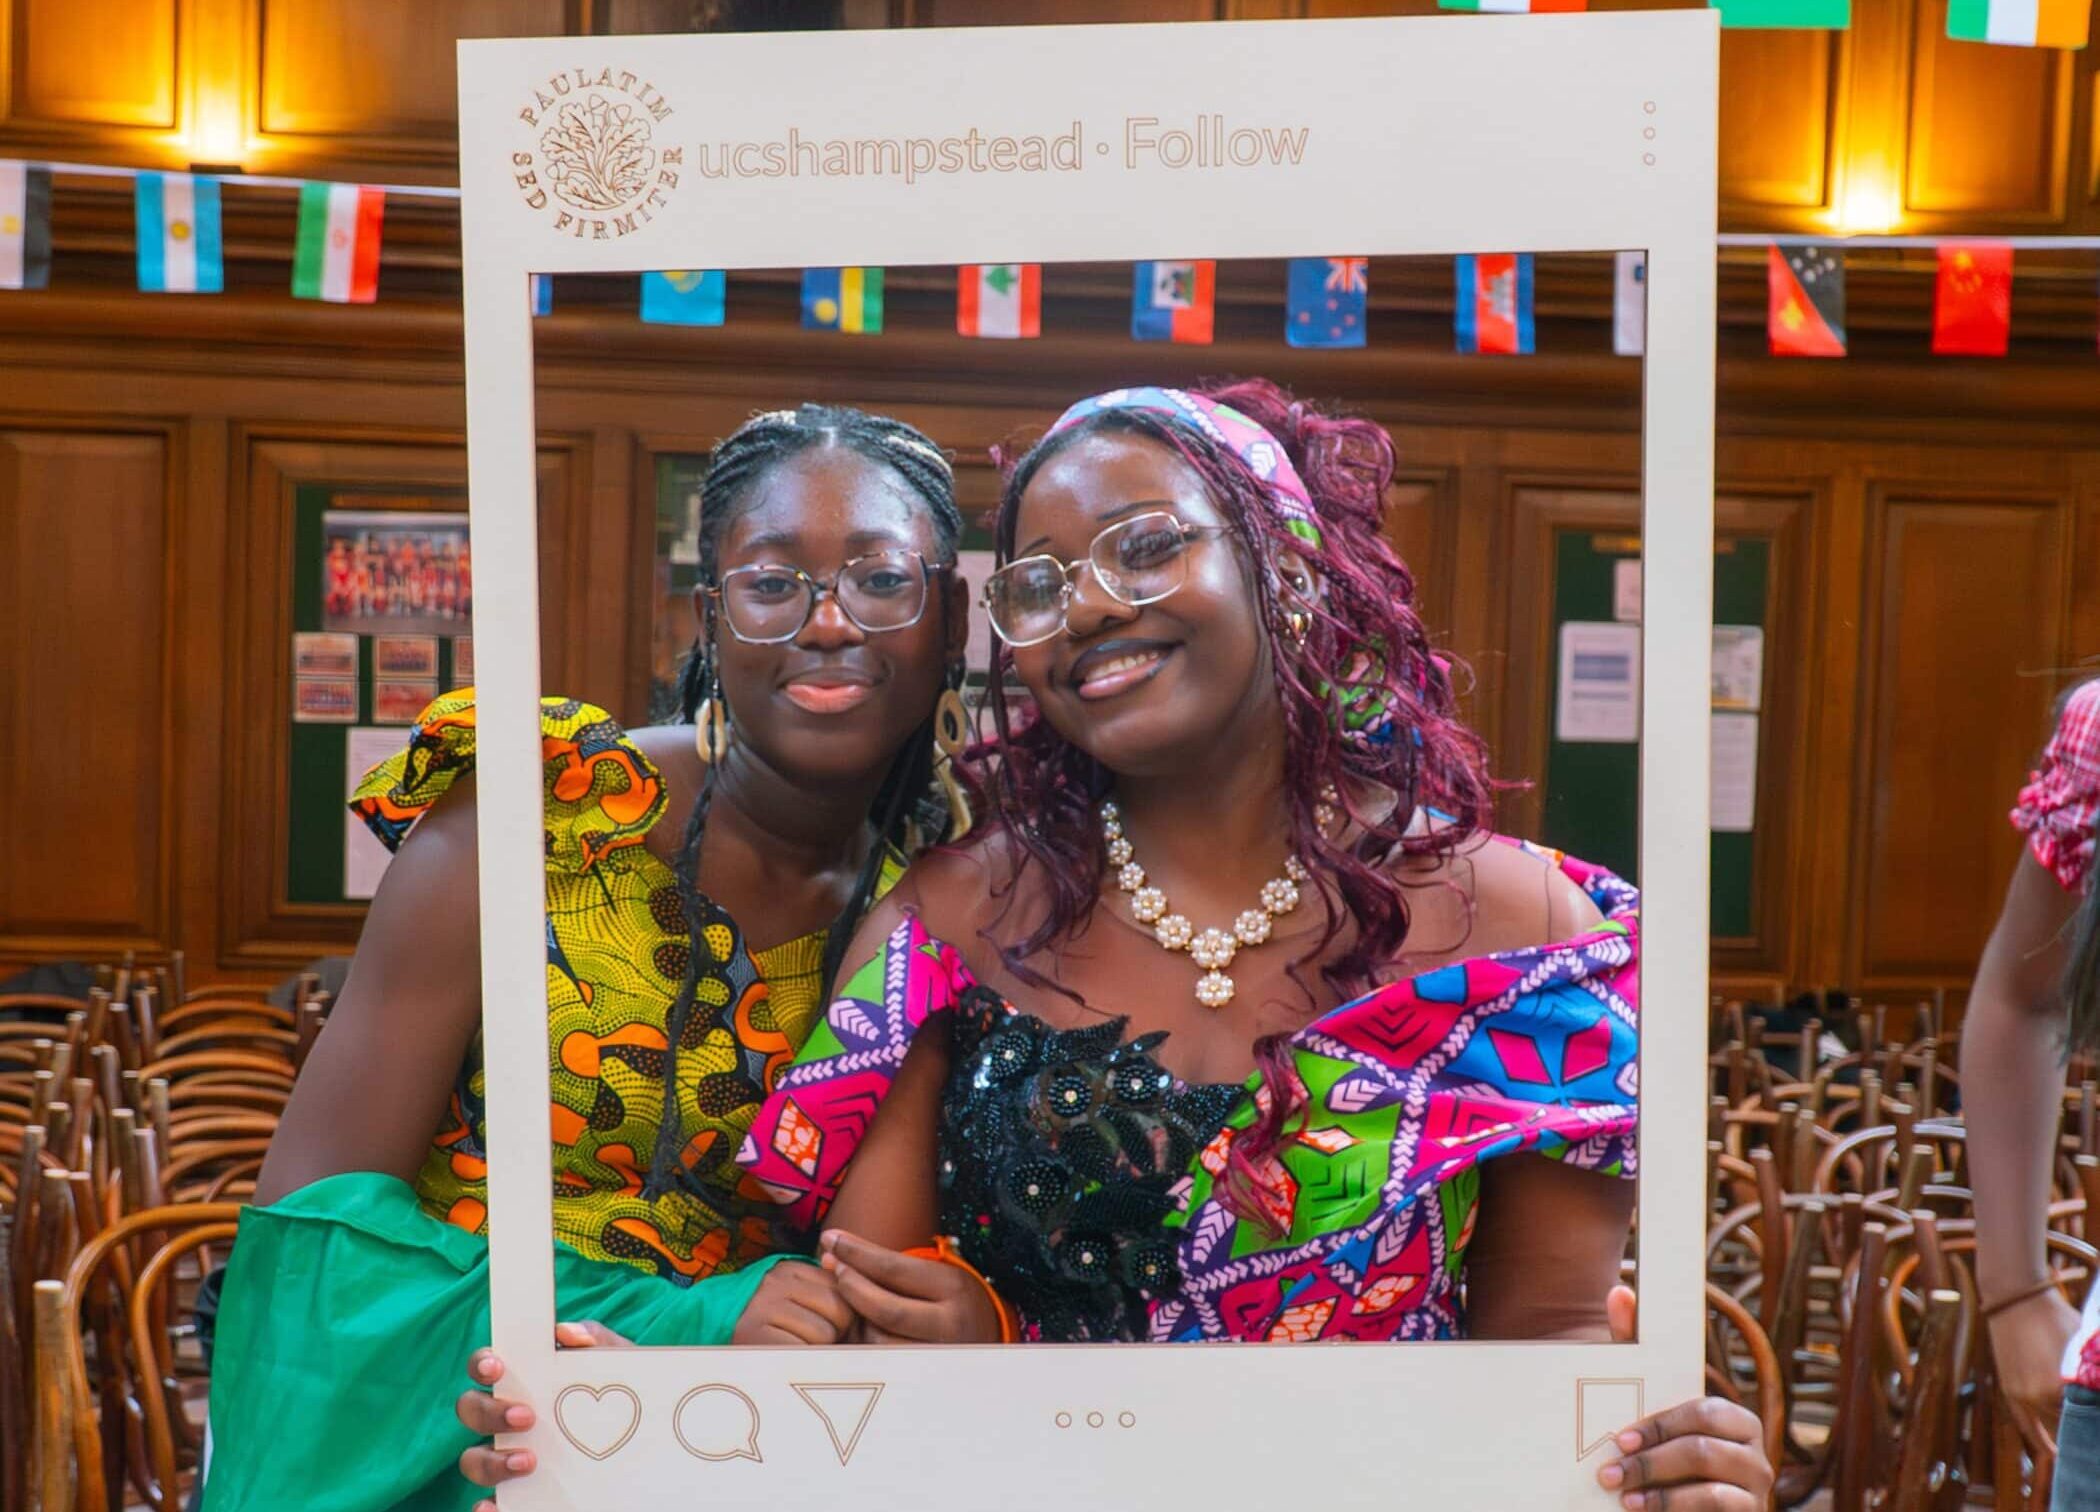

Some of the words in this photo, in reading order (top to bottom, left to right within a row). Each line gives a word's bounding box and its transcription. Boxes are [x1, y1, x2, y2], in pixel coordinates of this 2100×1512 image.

[519, 67, 674, 127] PAULATIM
[699, 120, 1082, 185] ucshampstead
[1125, 114, 1310, 169] Follow
[512, 152, 548, 211] SED
[553, 147, 683, 240] FIRMITER
